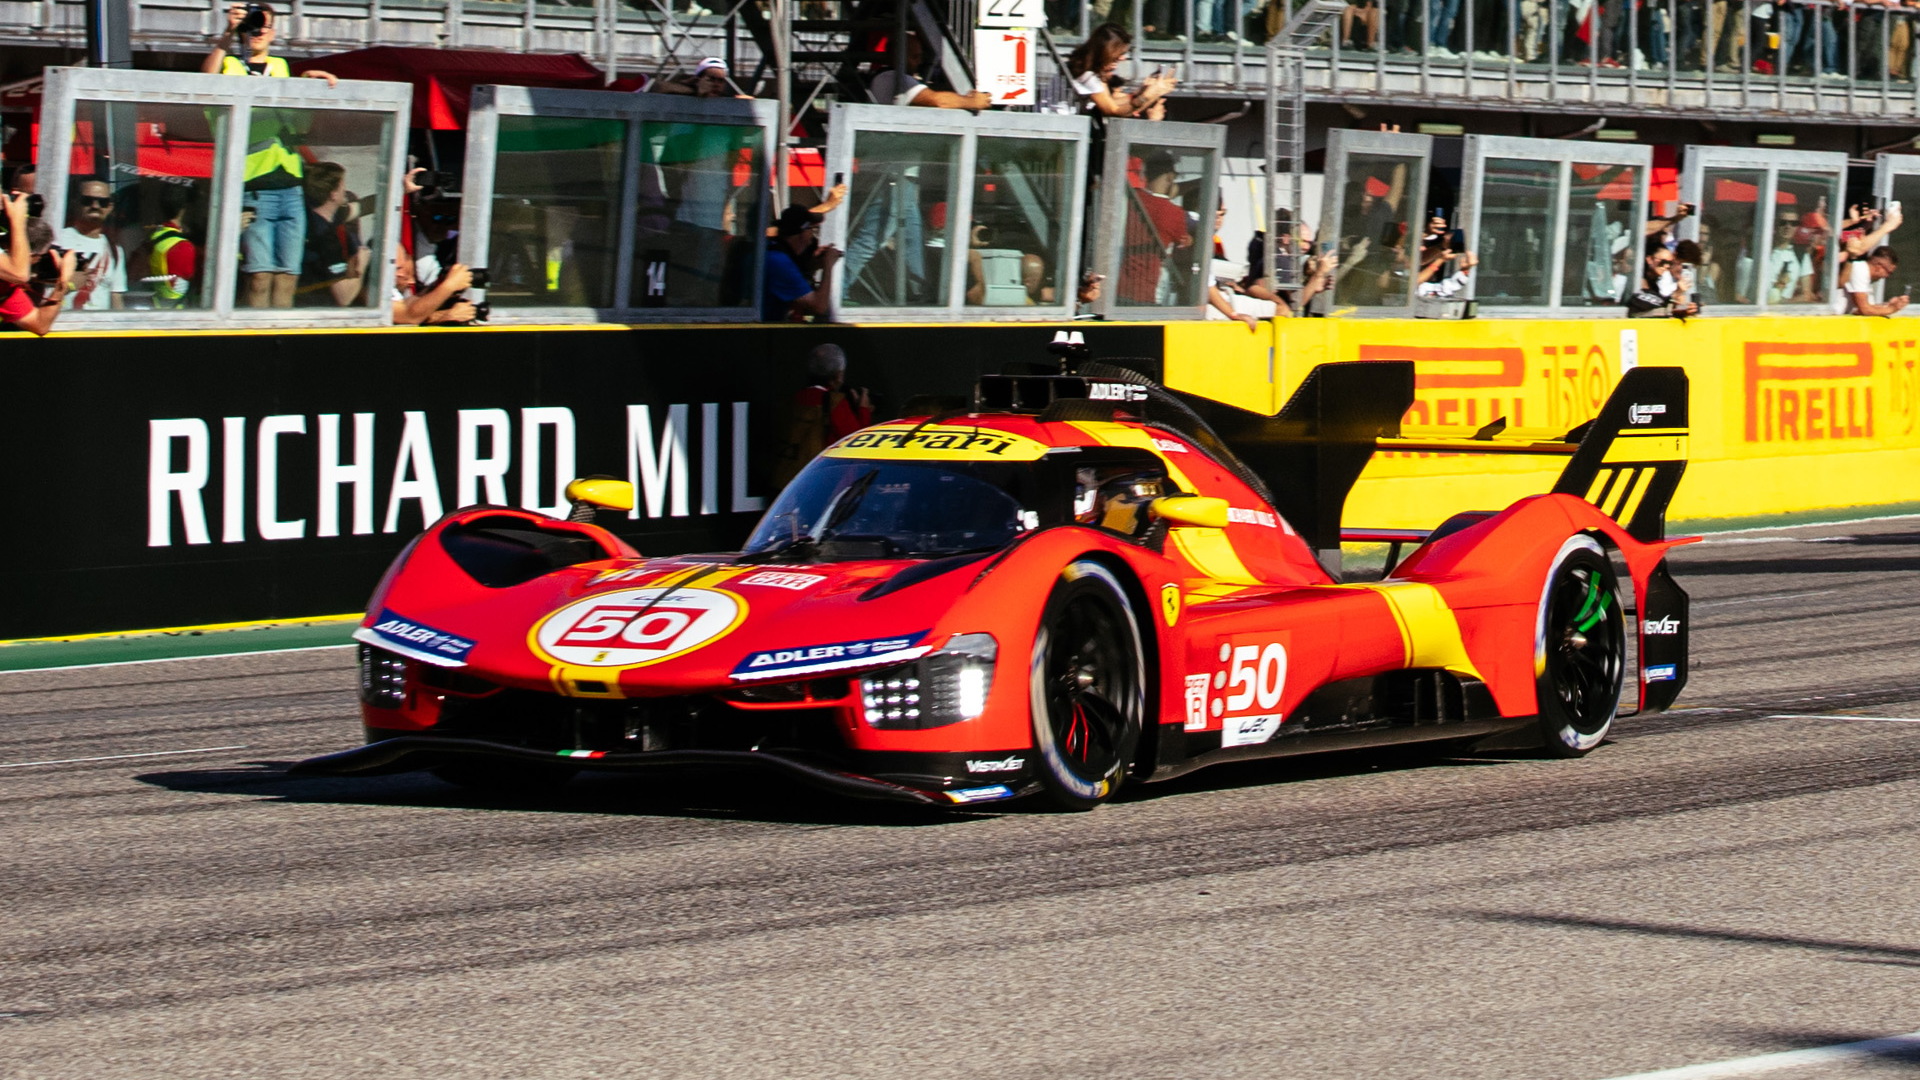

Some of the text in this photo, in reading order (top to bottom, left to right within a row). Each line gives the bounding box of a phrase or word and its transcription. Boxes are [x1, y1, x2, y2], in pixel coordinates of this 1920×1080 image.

[1359, 344, 1526, 459] PRELLI
[1744, 341, 1873, 442] PIRELLI
[838, 428, 1018, 456] errari
[147, 406, 577, 548] RICHARD
[373, 620, 437, 643] ADLER
[563, 610, 691, 644] 50
[748, 645, 845, 668] ADLER
[1227, 642, 1288, 711] 50
